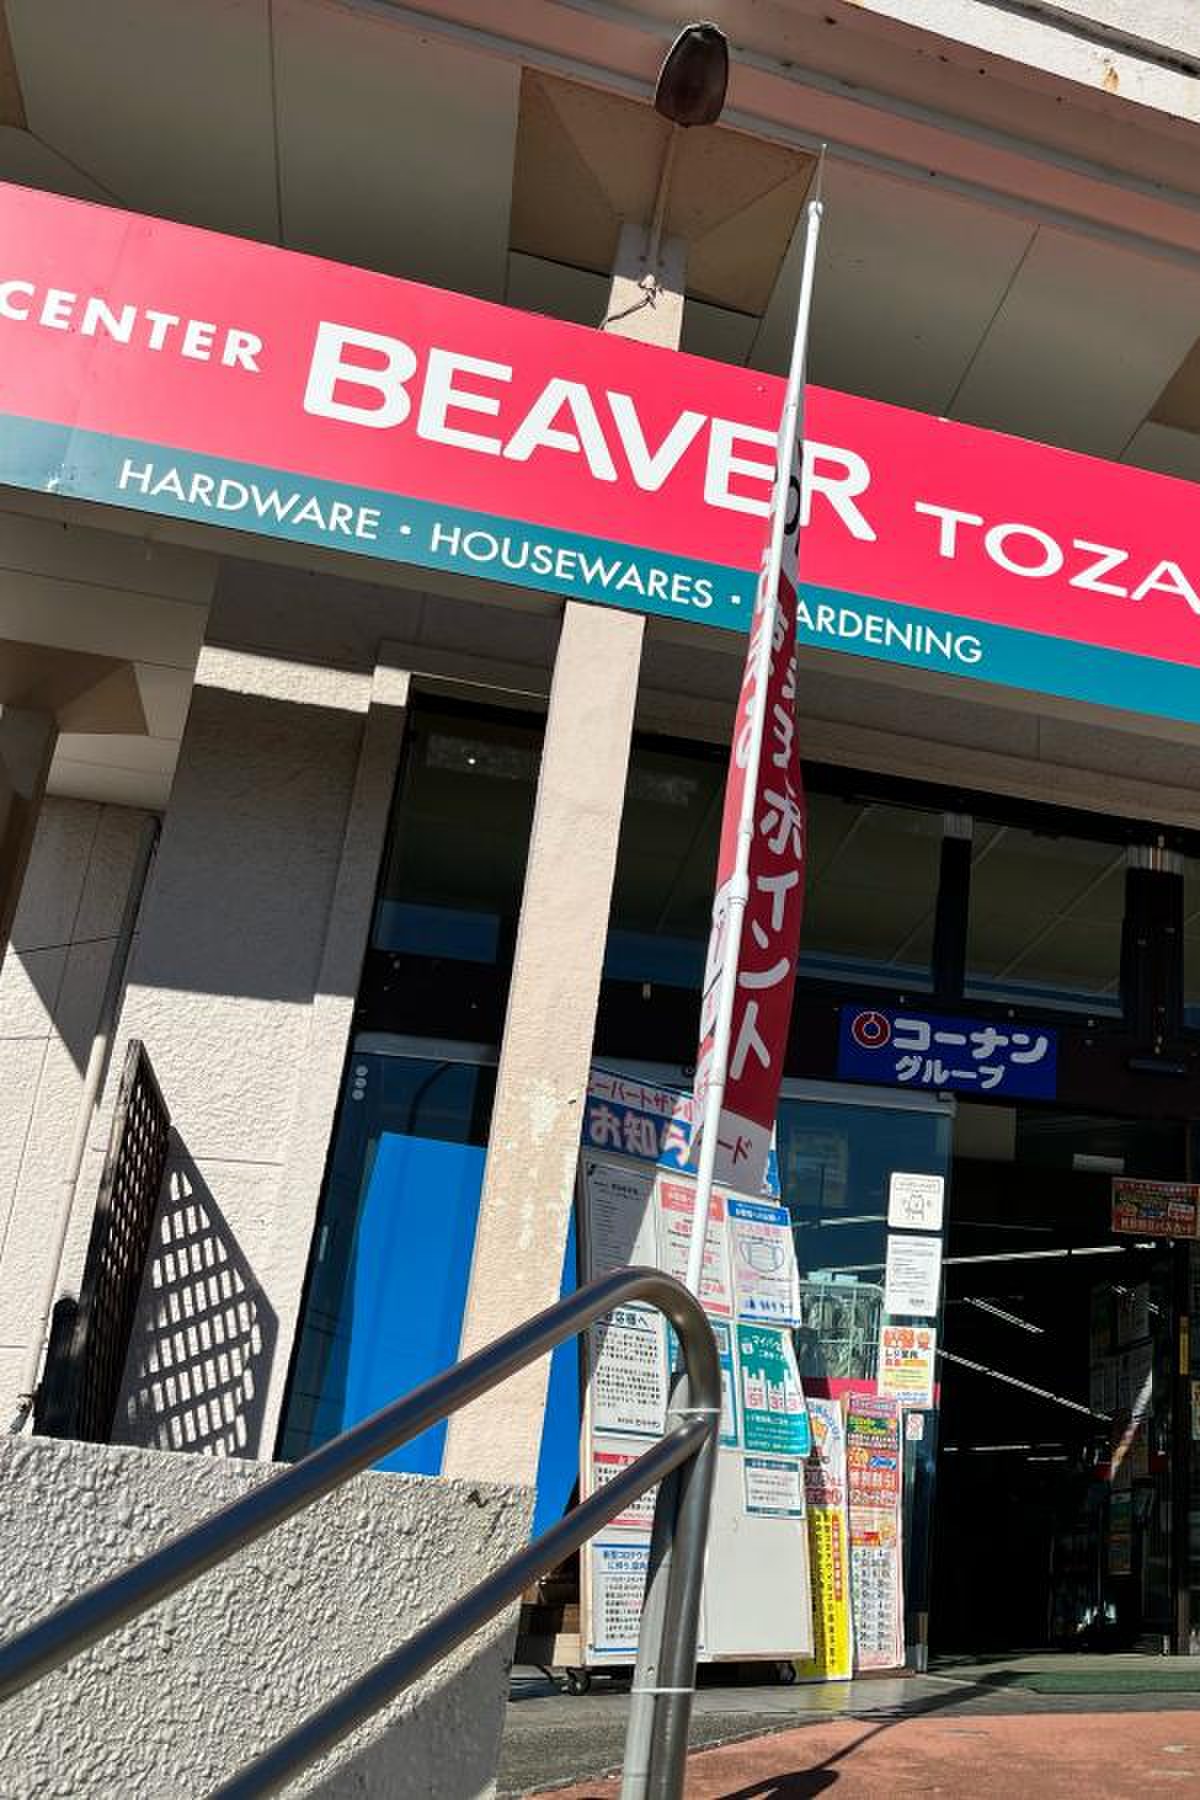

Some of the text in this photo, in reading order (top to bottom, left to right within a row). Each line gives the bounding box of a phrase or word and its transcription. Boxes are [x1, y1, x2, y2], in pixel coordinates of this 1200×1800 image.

[0, 280, 264, 374] CENTER
[303, 321, 878, 543] BEAVER
[117, 458, 984, 664] HARDWARE HOUSEWARES ARDENING
[894, 1017, 1049, 1065] コーナン
[895, 1055, 1006, 1090] グループ
